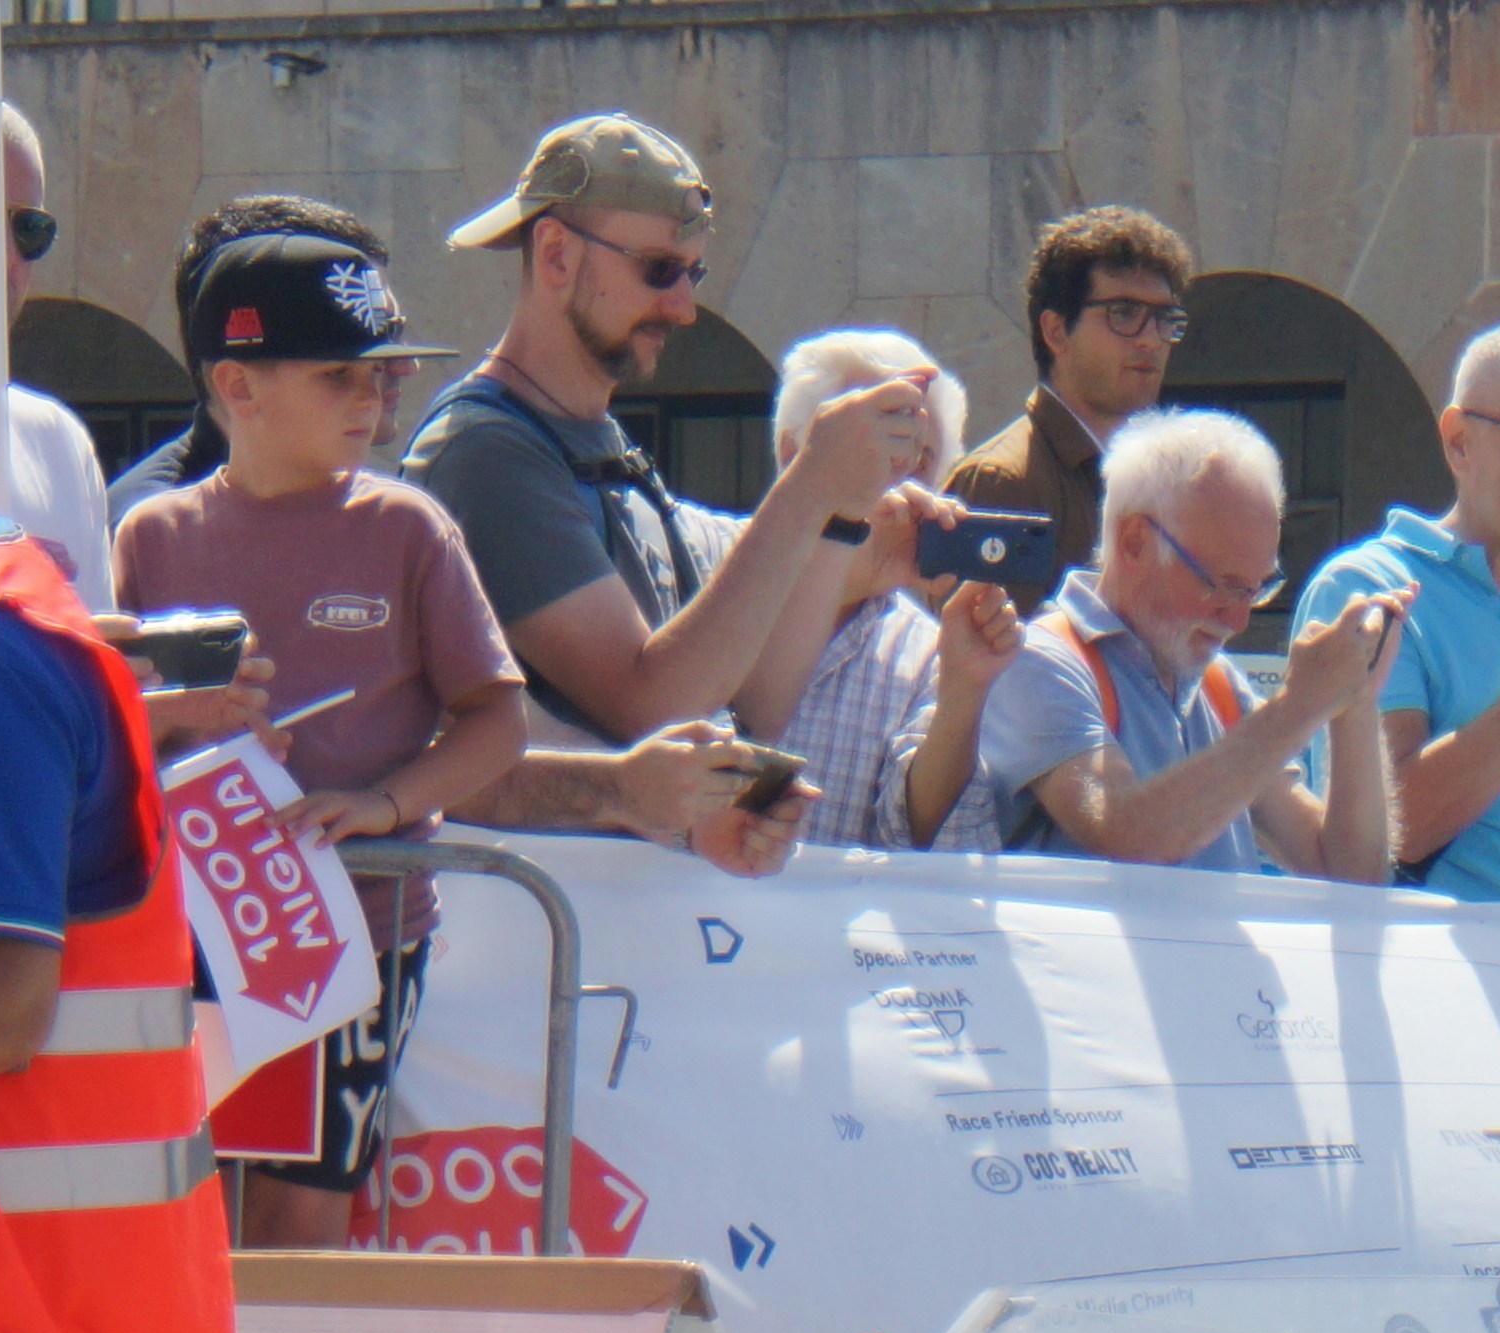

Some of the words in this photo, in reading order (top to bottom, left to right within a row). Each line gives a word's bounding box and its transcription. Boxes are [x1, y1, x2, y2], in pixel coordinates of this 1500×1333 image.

[216, 773, 330, 948] MIGLIA
[179, 808, 279, 962] 1000
[853, 949, 911, 972] Special
[916, 950, 977, 968] Partner
[946, 1113, 992, 1132] Race
[994, 1109, 1051, 1130] Friend
[1054, 1107, 1125, 1128] Sponsor
[1063, 1147, 1139, 1178] REALTY
